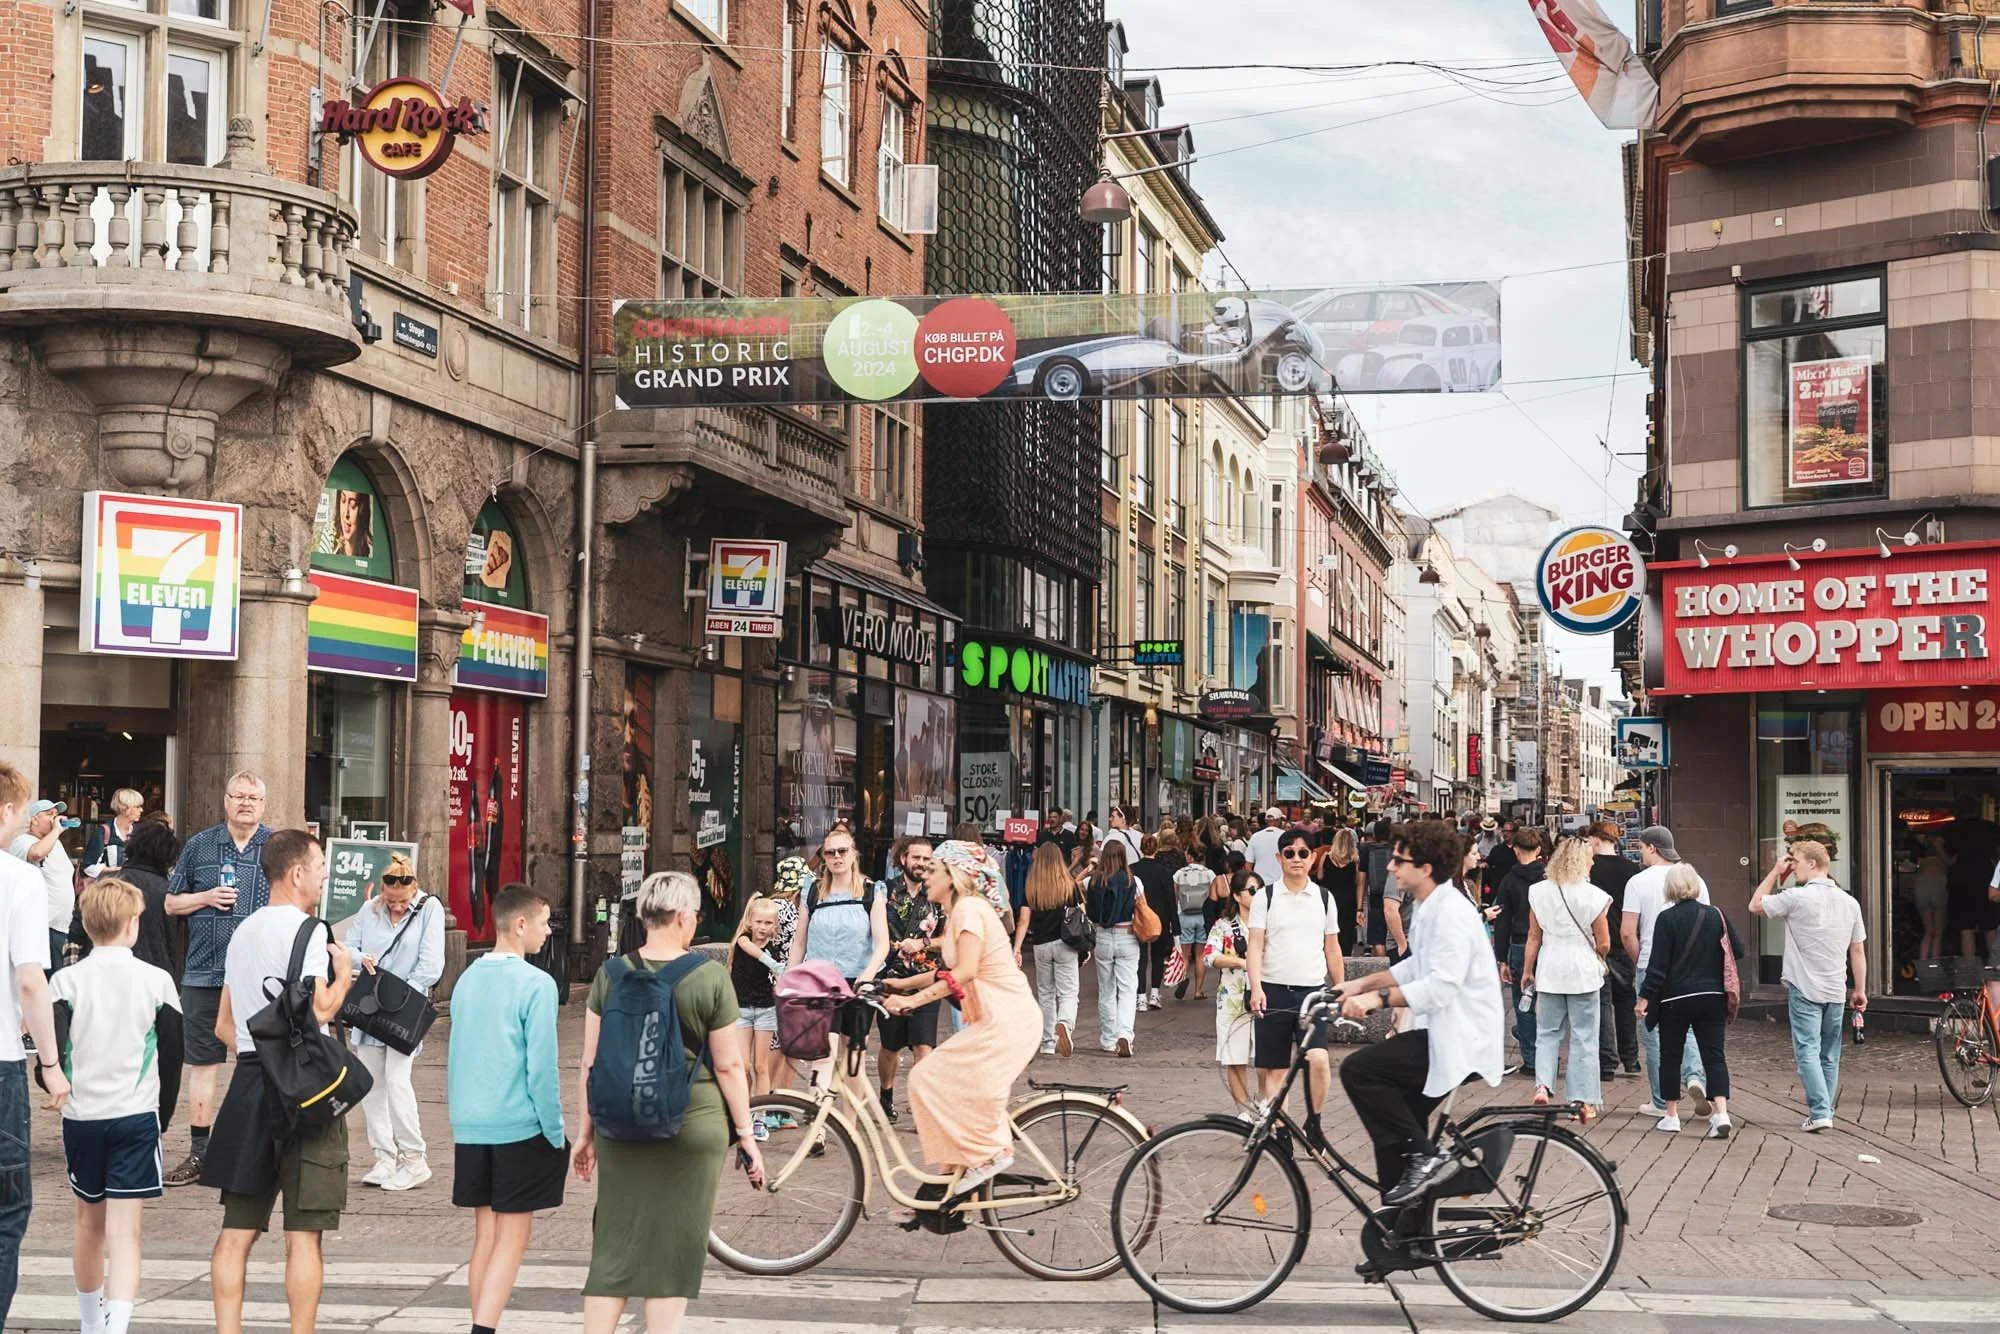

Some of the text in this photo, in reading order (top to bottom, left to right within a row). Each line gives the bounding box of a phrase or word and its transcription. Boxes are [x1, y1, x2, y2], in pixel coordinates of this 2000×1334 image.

[320, 96, 474, 138] Hard Rock
[381, 142, 421, 158] CAFE
[924, 329, 1005, 344] KØB BILLET PÅ
[635, 341, 789, 365] HISTORIC
[838, 340, 911, 357] AUGUST
[924, 346, 1006, 364] CHGP.DK
[634, 366, 790, 389] GRAND PRIX
[852, 361, 898, 377] 2024
[1796, 369, 1818, 381] Mix
[1830, 365, 1865, 378] Match
[1799, 381, 1812, 400] 2
[1824, 378, 1853, 397] 119
[1547, 545, 1631, 584] BURGER
[130, 527, 207, 645] 7
[727, 554, 764, 607] 7
[1552, 562, 1634, 611] KING
[1675, 569, 1989, 618] HOME OF THE
[733, 621, 747, 633] 24
[751, 623, 773, 632] TIMER
[841, 608, 933, 667] VERO MODA
[1675, 613, 1989, 669] WHOPPER
[1139, 642, 1178, 652] SPORT
[1208, 690, 1250, 702] SHAWARMA
[1880, 699, 2000, 732] OPEN 2
[969, 762, 999, 776] STORE
[961, 776, 1003, 789] CLOSING
[1008, 822, 1034, 835] 150,-
[333, 886, 357, 896] hotdog
[334, 878, 357, 887] Fransk
